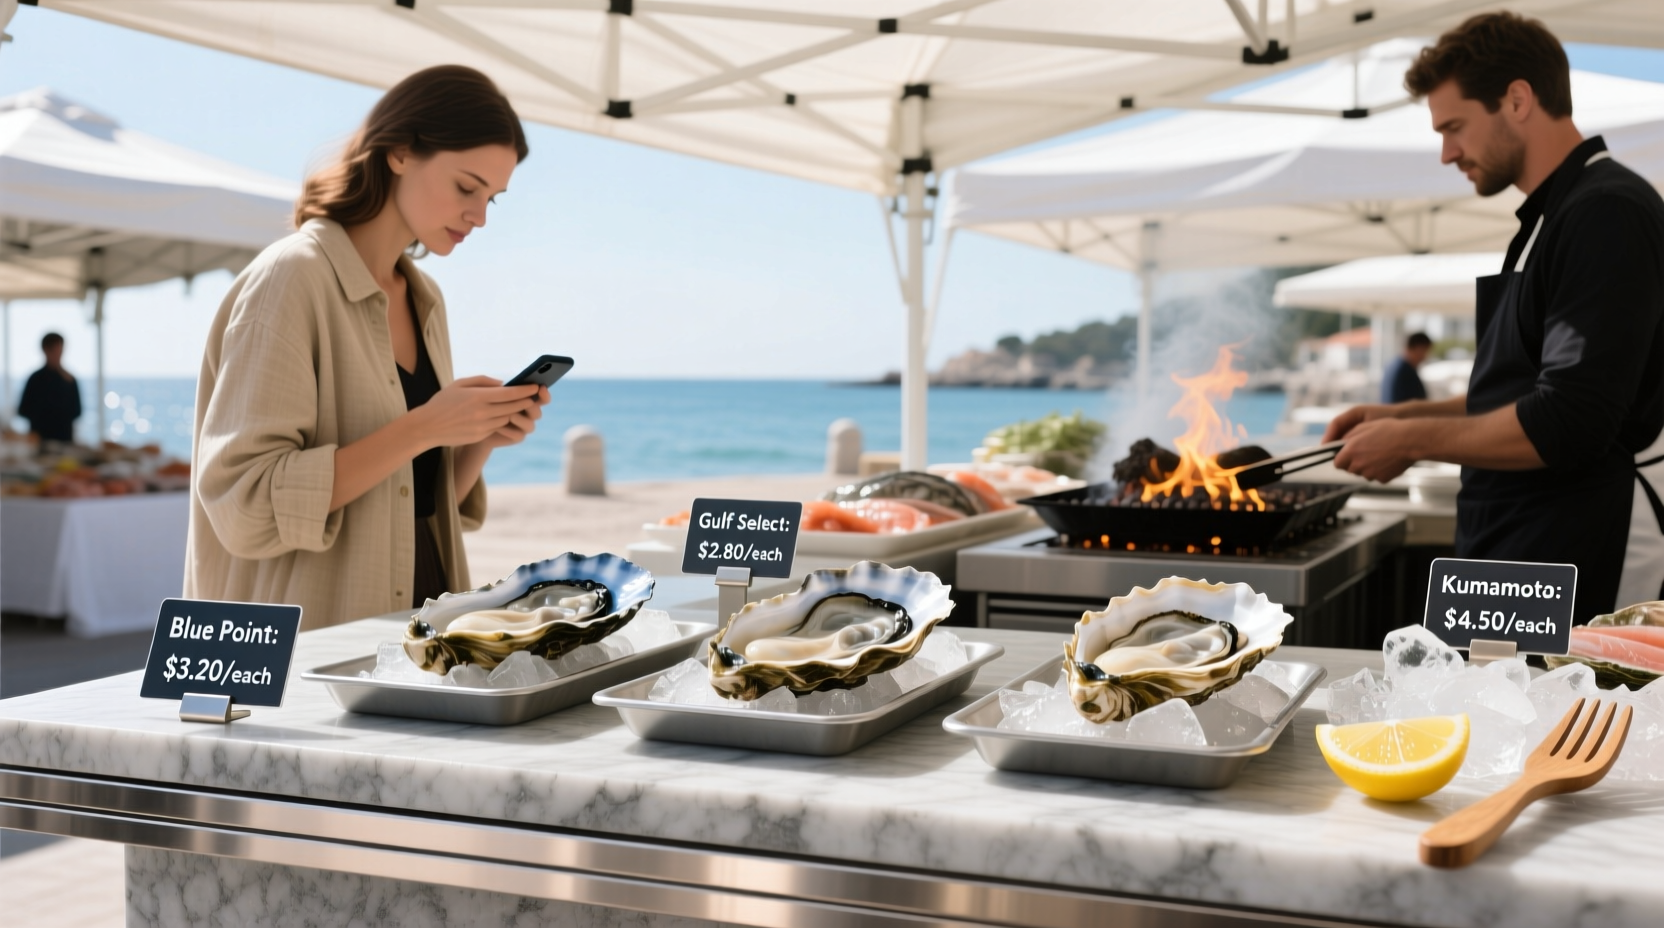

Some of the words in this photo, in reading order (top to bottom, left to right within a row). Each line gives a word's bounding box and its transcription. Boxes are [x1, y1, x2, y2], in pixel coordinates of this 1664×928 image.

[698, 511, 736, 530] Gulf
[736, 513, 790, 532] Select:
[697, 540, 783, 562] $2.80/each
[1441, 574, 1562, 600] Kumamoto:
[168, 615, 215, 642] Blue
[218, 619, 279, 645] Point:
[1443, 606, 1557, 635] $4.50/each
[162, 653, 272, 686] $3.20/each
